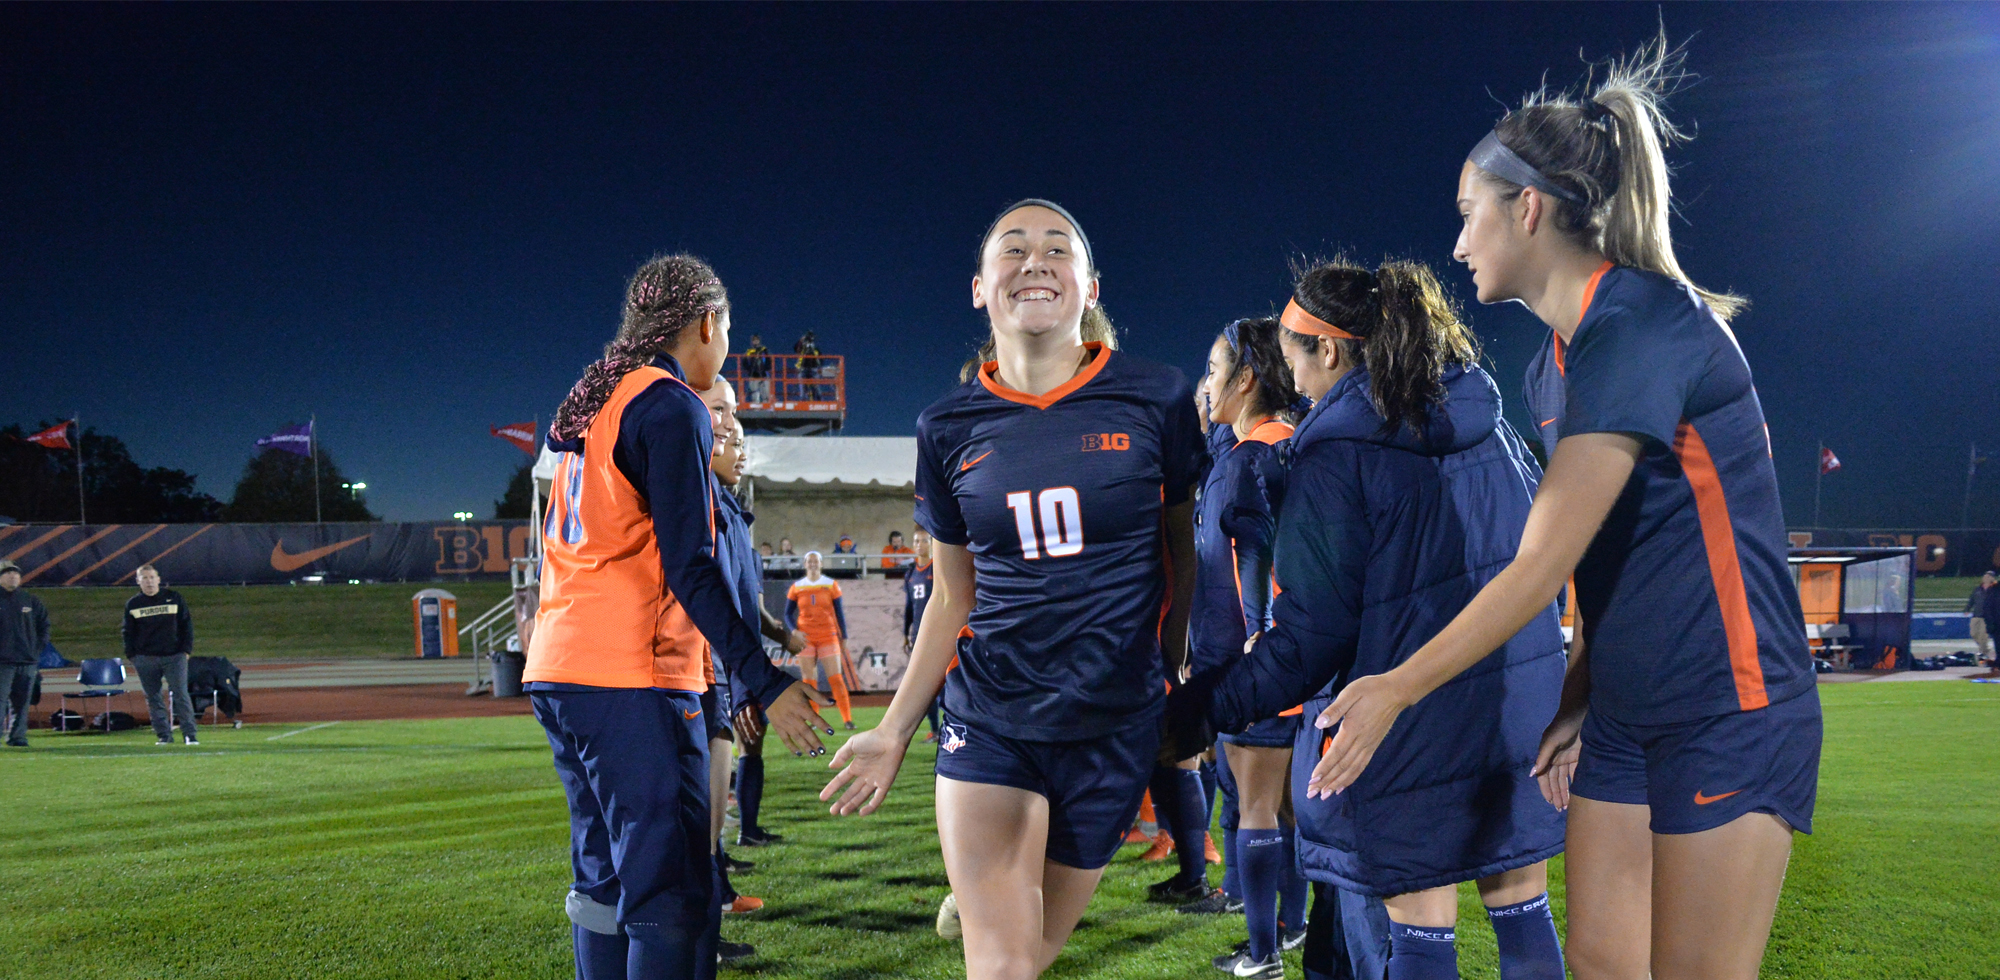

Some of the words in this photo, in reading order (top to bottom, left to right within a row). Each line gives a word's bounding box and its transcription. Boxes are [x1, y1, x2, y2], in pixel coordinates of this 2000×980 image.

[1006, 485, 1084, 560] 10
[913, 584, 925, 599] 23
[140, 606, 169, 615] PURDUE
[1489, 907, 1519, 917] NIKE
[1407, 928, 1442, 939] NIKE
